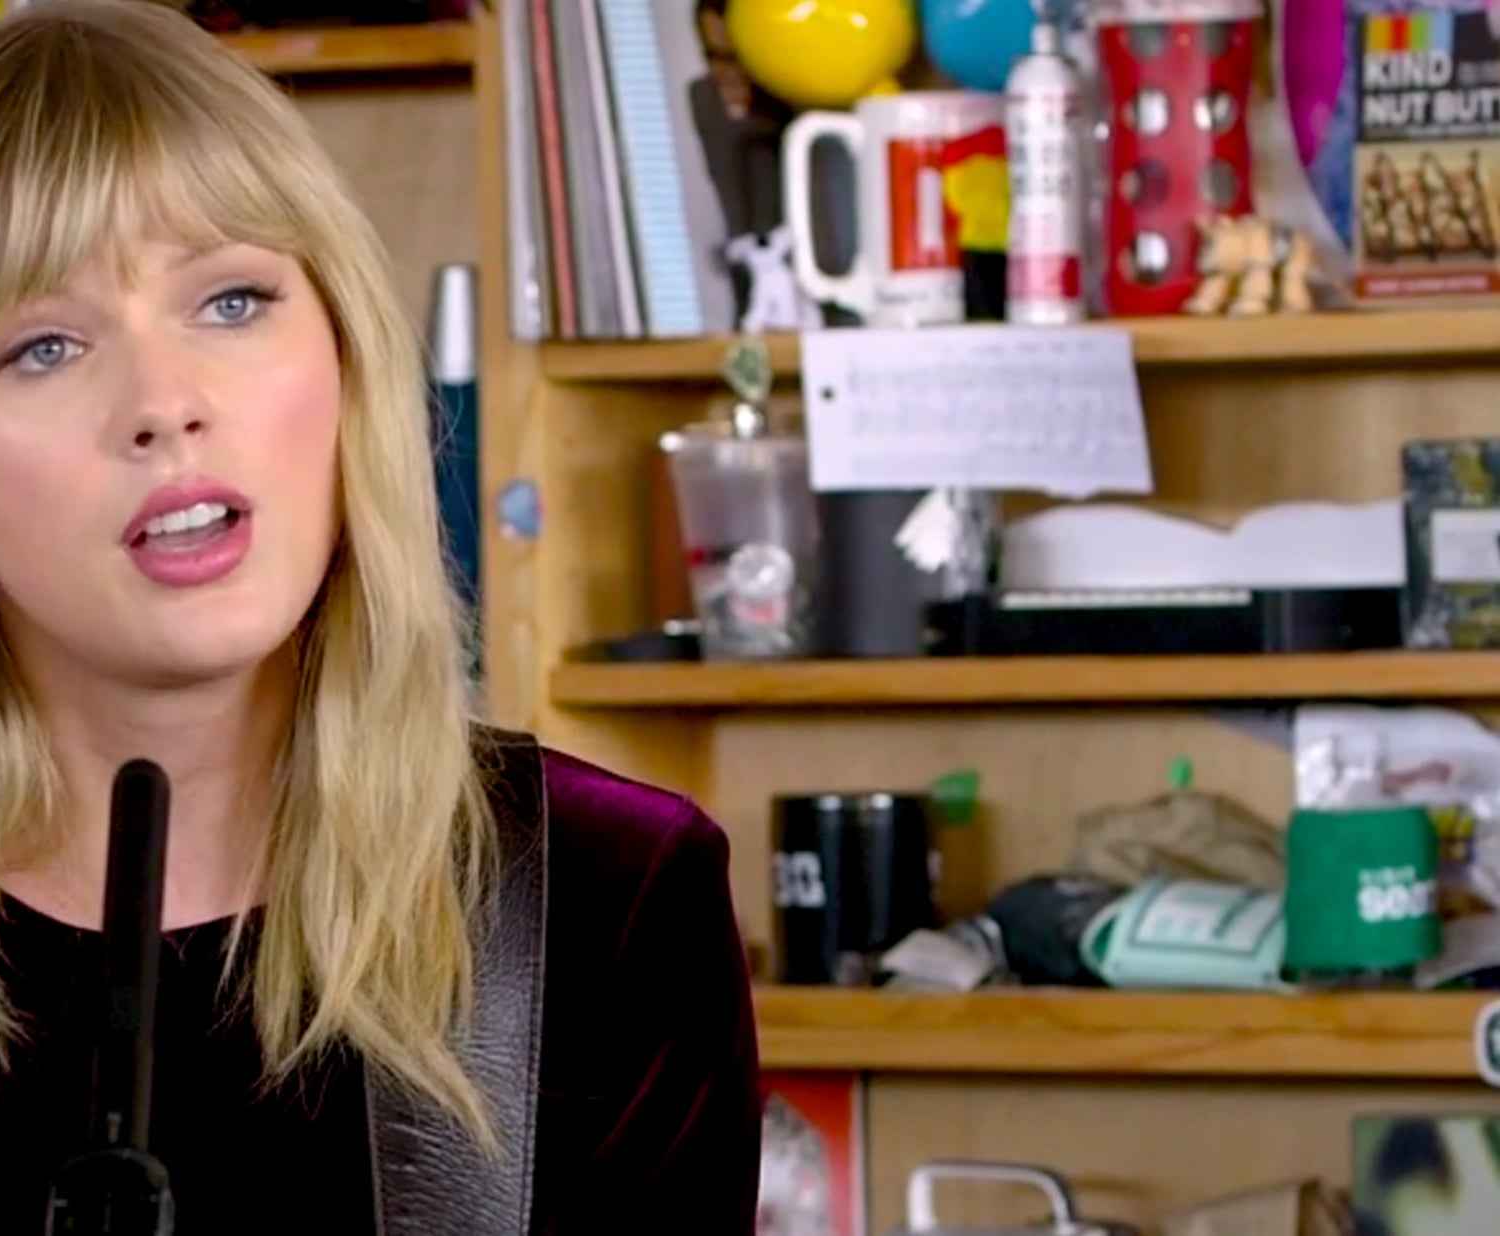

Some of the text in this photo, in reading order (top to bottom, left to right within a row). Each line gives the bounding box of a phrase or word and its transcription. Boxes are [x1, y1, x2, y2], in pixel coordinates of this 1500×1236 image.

[1362, 53, 1453, 89] KIND
[1362, 87, 1500, 125] NUT BUT
